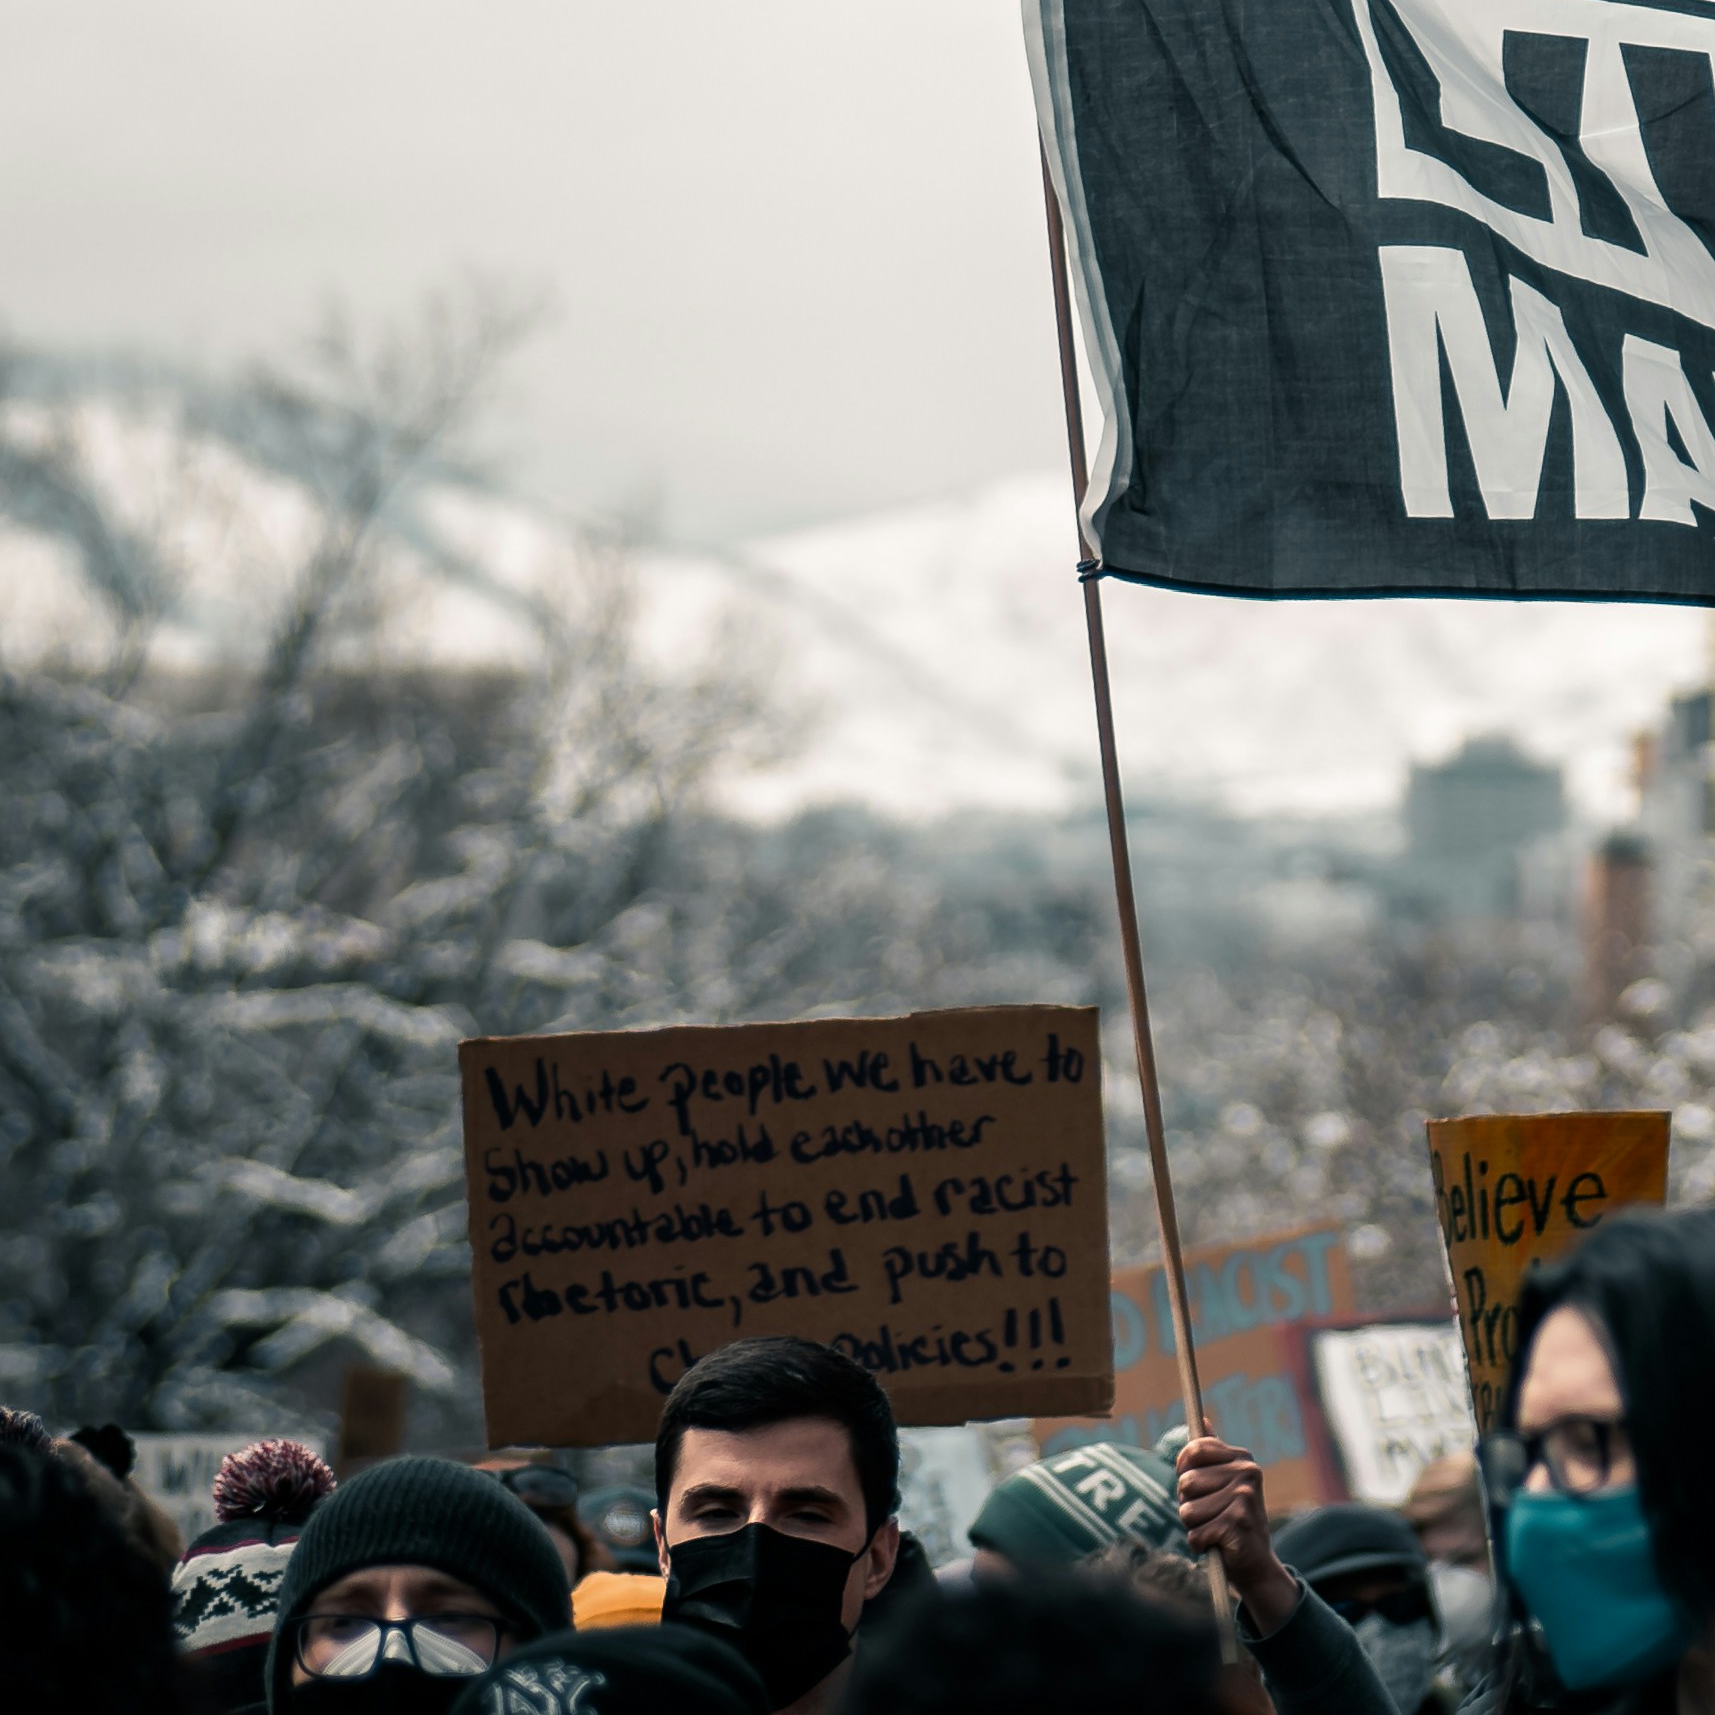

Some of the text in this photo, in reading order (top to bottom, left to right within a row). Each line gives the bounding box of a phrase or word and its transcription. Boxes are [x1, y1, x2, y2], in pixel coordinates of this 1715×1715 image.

[485, 1056, 650, 1131] White
[909, 1041, 1034, 1089] have
[1038, 1032, 1085, 1085] to
[690, 1122, 781, 1170] hold
[751, 1189, 814, 1238] to
[824, 1172, 922, 1226] end
[932, 1162, 1080, 1217] racist
[747, 1247, 860, 1303] and
[882, 1231, 1004, 1306] push
[1009, 1231, 1068, 1280] to
